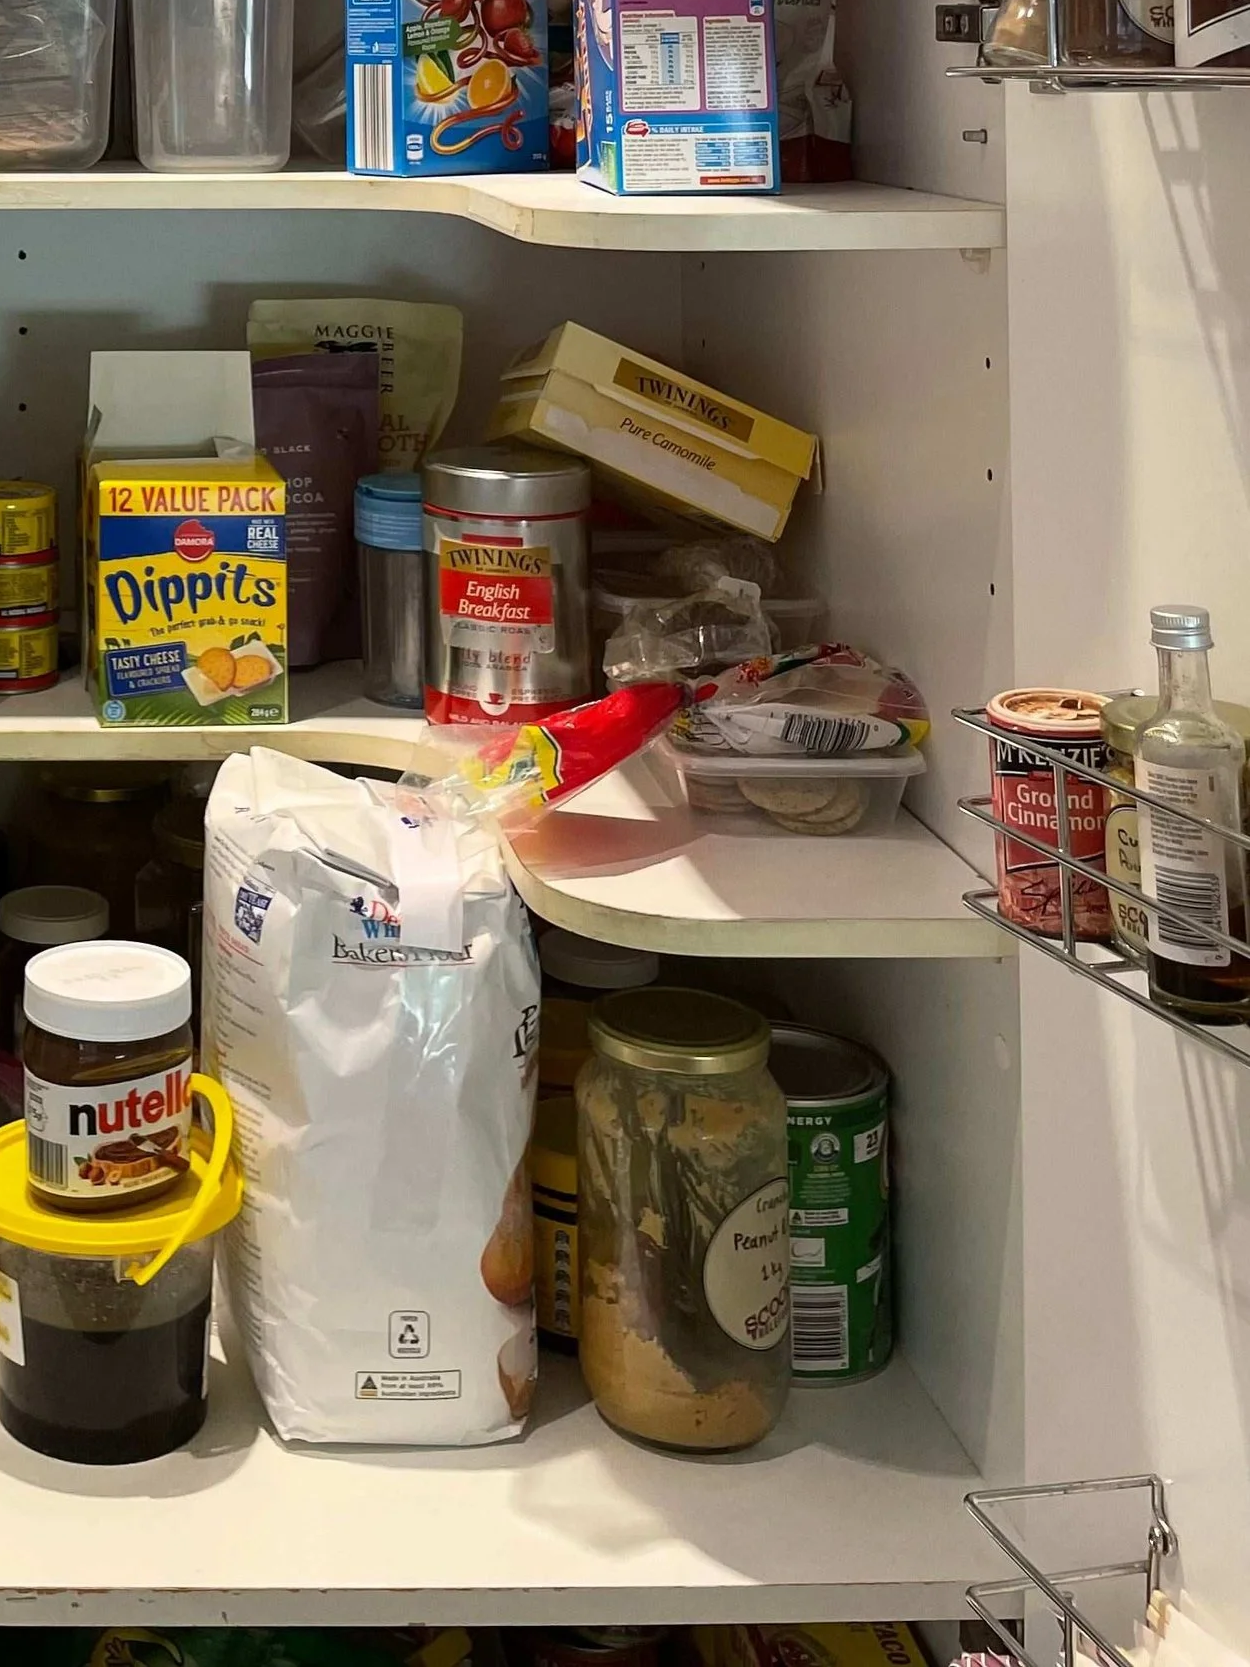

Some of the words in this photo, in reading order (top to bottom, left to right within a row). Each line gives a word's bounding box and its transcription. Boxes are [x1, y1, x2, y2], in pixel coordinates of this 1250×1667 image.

[605, 112, 614, 133] 15
[314, 324, 394, 339] MAGGIE
[381, 343, 394, 394] BEER
[636, 376, 732, 429] TWININGS
[274, 445, 311, 454] BLACK
[379, 435, 428, 452] OTH
[620, 418, 650, 441] Pure
[652, 433, 717, 471] Camomile
[109, 487, 133, 512] 12
[141, 487, 210, 512] VALUE
[218, 486, 277, 512] PACK
[174, 537, 214, 546] DAMORA
[247, 527, 279, 540] REAL
[247, 540, 279, 549] CHEESE
[447, 548, 543, 574] TWININGS
[104, 562, 278, 625] Dippits
[466, 581, 520, 602] English
[458, 599, 530, 622] Breakfast
[150, 627, 165, 637] The
[167, 620, 195, 634] perfect
[111, 655, 140, 670] TASTY
[143, 650, 181, 667] CHEESE
[489, 649, 531, 664] blend
[1017, 784, 1093, 810] Grond
[787, 1116, 832, 1126] NERGY
[734, 1224, 778, 1251] Peanut
